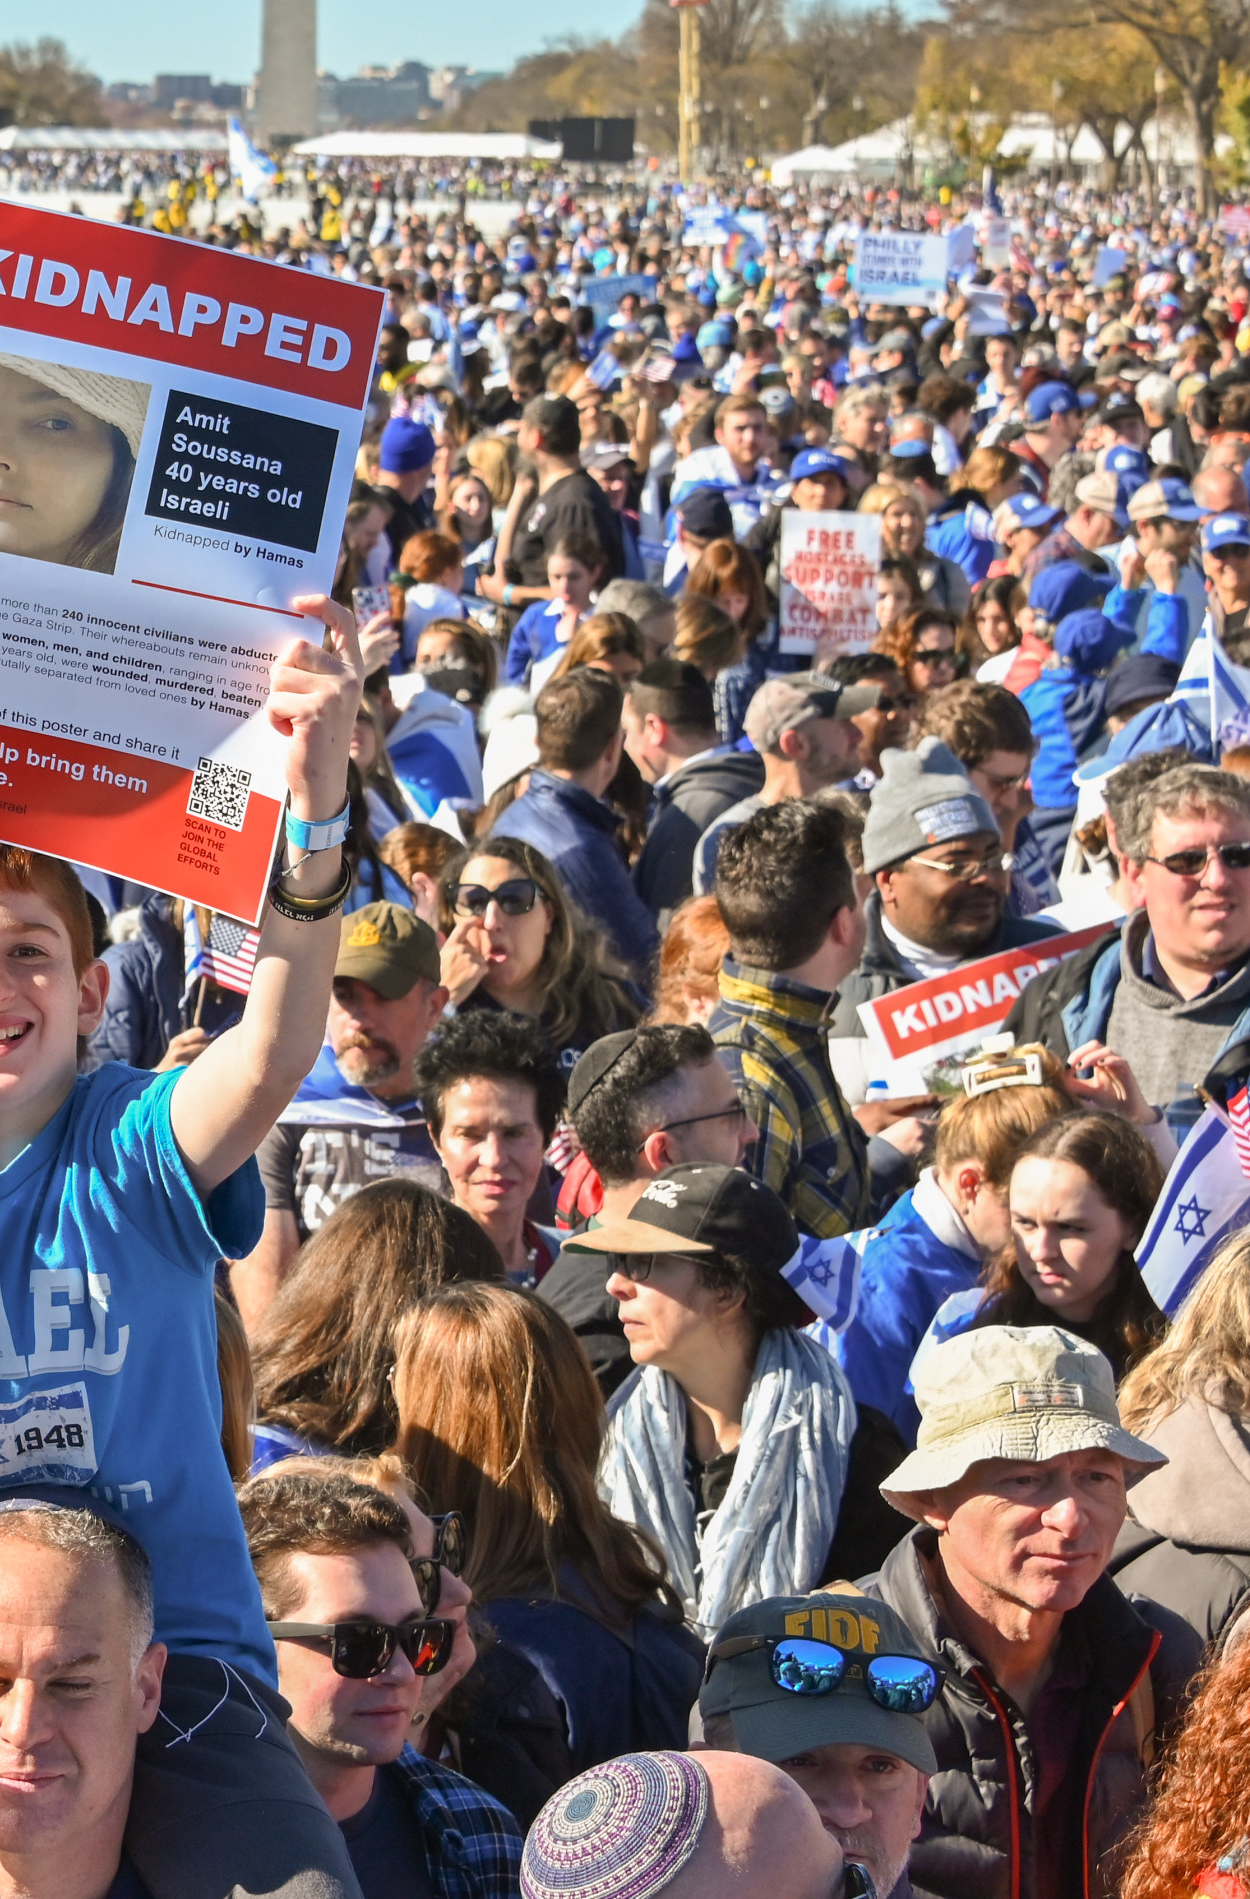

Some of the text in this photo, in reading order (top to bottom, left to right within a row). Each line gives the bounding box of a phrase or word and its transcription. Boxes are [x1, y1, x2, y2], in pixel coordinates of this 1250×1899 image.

[863, 238, 922, 252] PHILLY
[859, 269, 921, 286] ISRAEL
[175, 406, 231, 434] Amit
[171, 433, 283, 475] Soussana
[165, 461, 303, 509] 40 years old
[159, 488, 230, 520] Israeli
[153, 524, 304, 569] Kidnapped by Hamas
[806, 529, 855, 549] FREE
[782, 565, 877, 589] SUPPORT
[1, 597, 30, 611] more
[33, 603, 59, 616] than
[61, 608, 84, 622] 240
[87, 613, 141, 634] innocent
[143, 627, 195, 646] civilians
[198, 639, 228, 652] were
[231, 645, 279, 662] abducte
[788, 604, 871, 625] COMBAT
[12, 613, 43, 628] Gaza
[46, 620, 75, 635] Strip.
[80, 627, 108, 641] Their
[111, 634, 185, 658] whereabouts
[188, 650, 228, 666] remain
[231, 660, 270, 676] unkno
[1, 646, 33, 659] years
[36, 651, 57, 665] old,
[61, 658, 89, 671] were
[92, 663, 151, 684] wounded,
[155, 677, 217, 698] murdered,
[2, 632, 49, 650] women,
[52, 642, 82, 657] men,
[85, 650, 109, 661] and
[112, 654, 165, 674] children,
[169, 666, 213, 684] ranging
[216, 675, 227, 686] in
[230, 680, 252, 693] age
[256, 683, 270, 696] fro
[34, 666, 92, 685] separated
[95, 677, 122, 691] from
[124, 683, 156, 698] loved
[159, 691, 188, 704] ones
[190, 697, 206, 710] by
[208, 700, 252, 720] Hamas.
[11, 711, 37, 727] this
[41, 718, 89, 739] poster
[92, 729, 121, 745] and
[125, 736, 167, 757] share
[170, 746, 180, 760] it
[25, 747, 86, 781] bring
[92, 763, 149, 794] them
[181, 830, 225, 852] JOIN THE
[184, 818, 227, 840] SCAN TO
[177, 853, 220, 876] EFFORTS
[179, 841, 218, 863] GLOBAL
[890, 949, 1081, 1039] KIDNAP
[15, 1423, 85, 1456] 1948
[784, 1607, 881, 1654] FIDF
